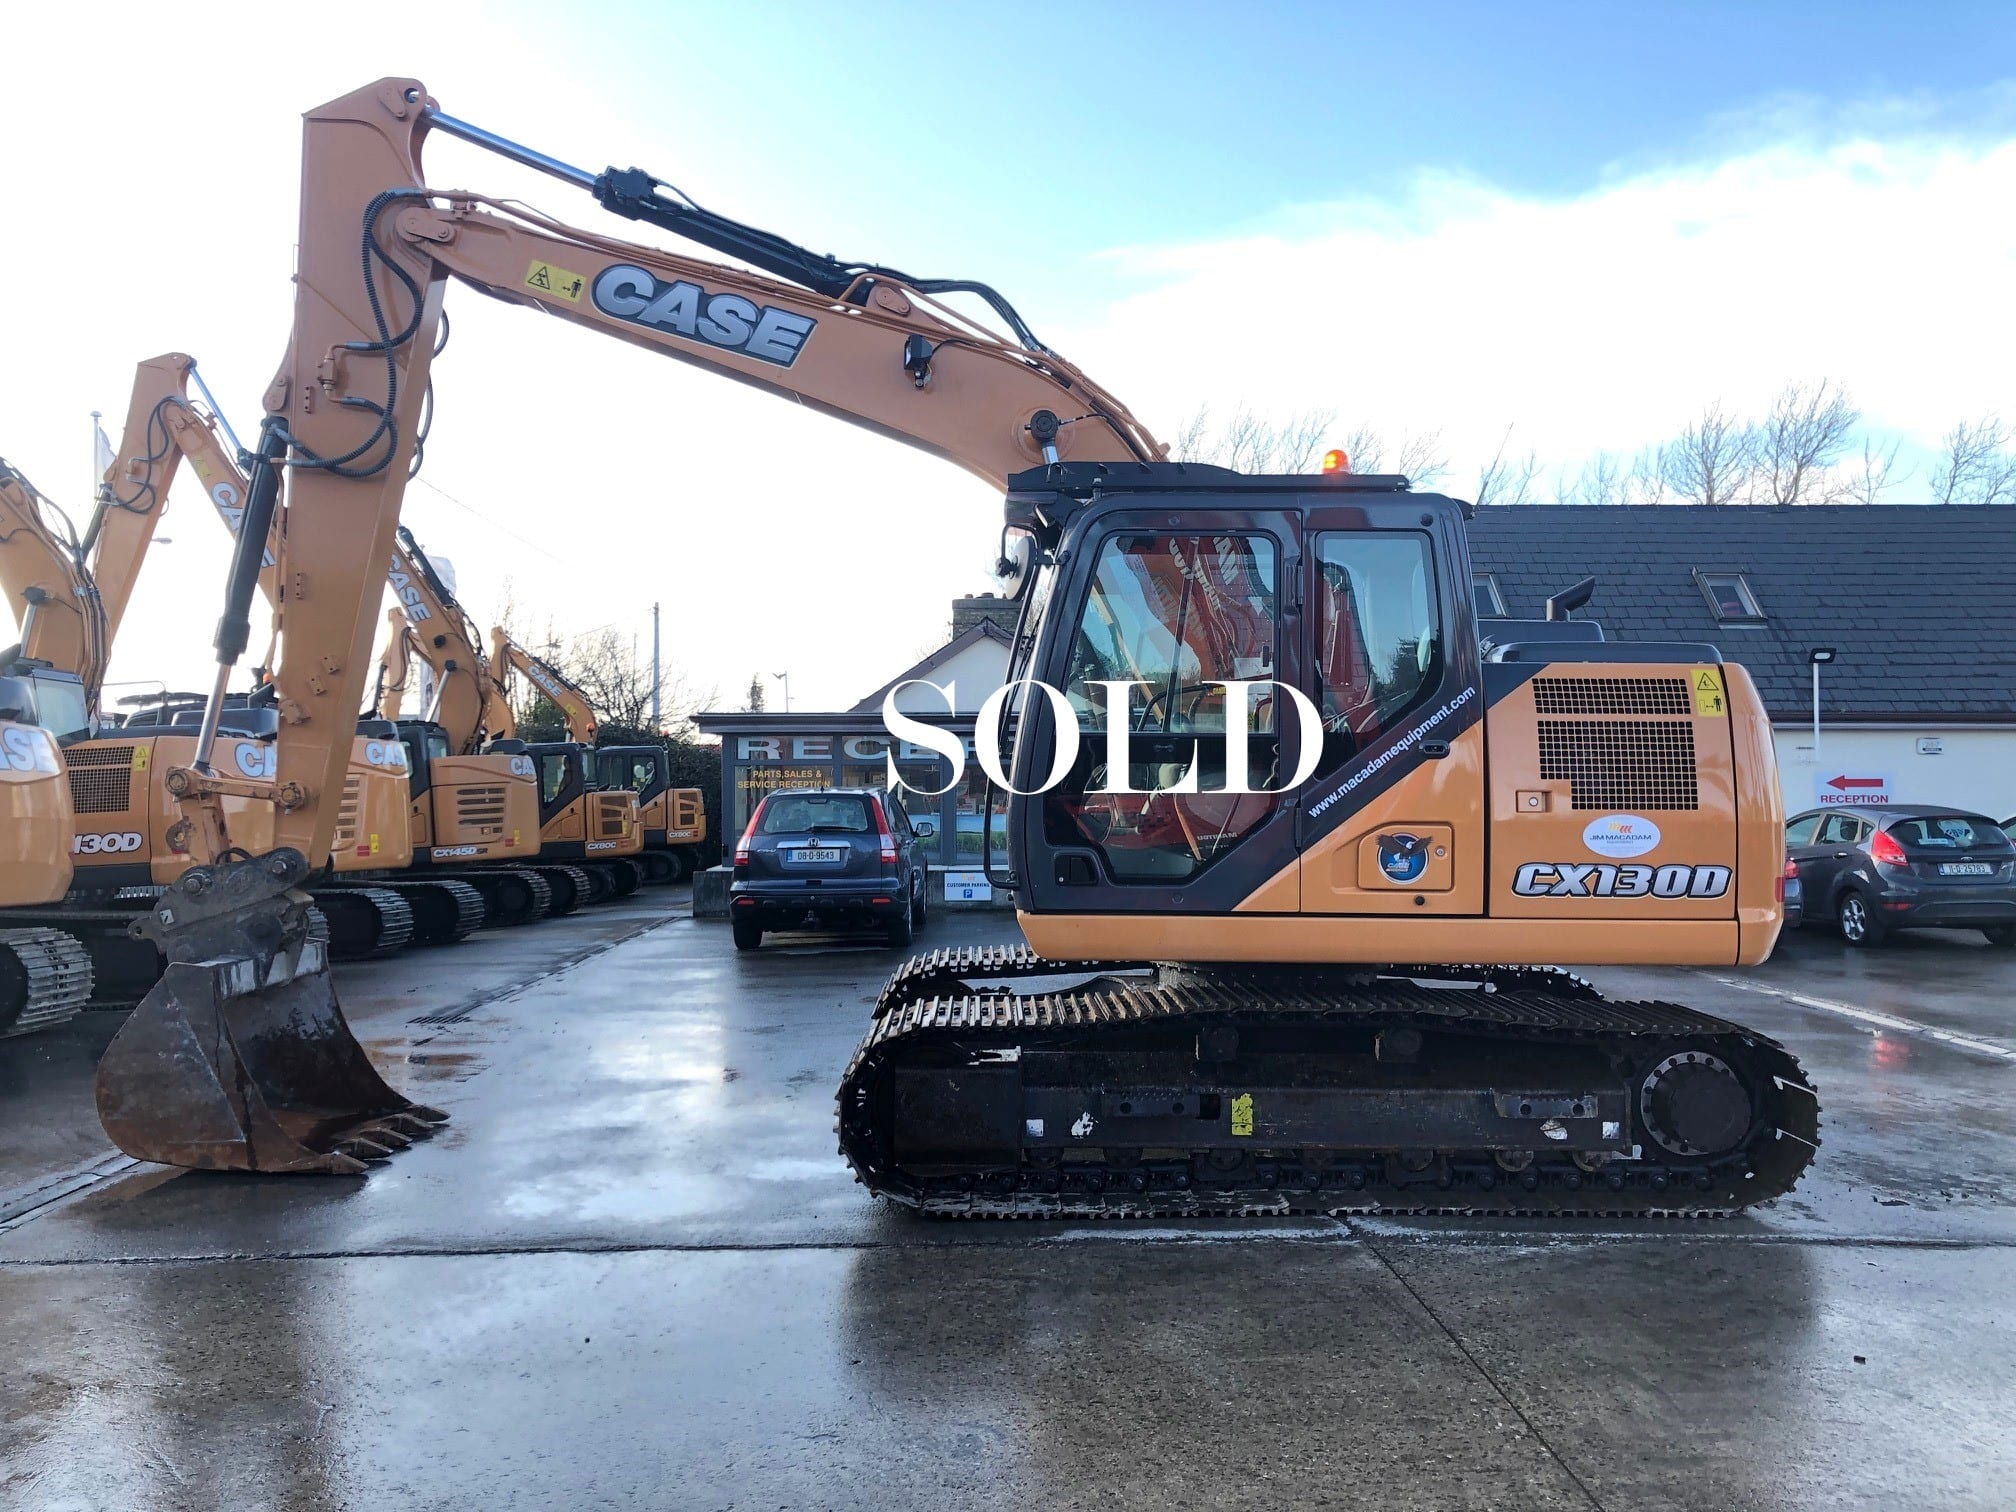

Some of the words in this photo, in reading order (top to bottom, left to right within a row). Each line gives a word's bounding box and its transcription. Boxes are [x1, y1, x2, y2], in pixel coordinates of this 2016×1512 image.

[593, 264, 814, 364] CASE
[528, 665, 562, 697] CASE
[1308, 686, 1476, 818] www.macadamequipment.com
[737, 780, 776, 789] SERVICE
[779, 780, 831, 789] RECEPTION
[815, 770, 822, 778] &
[1820, 794, 1889, 804] RECEPTION
[1512, 862, 1732, 898] CX130D
